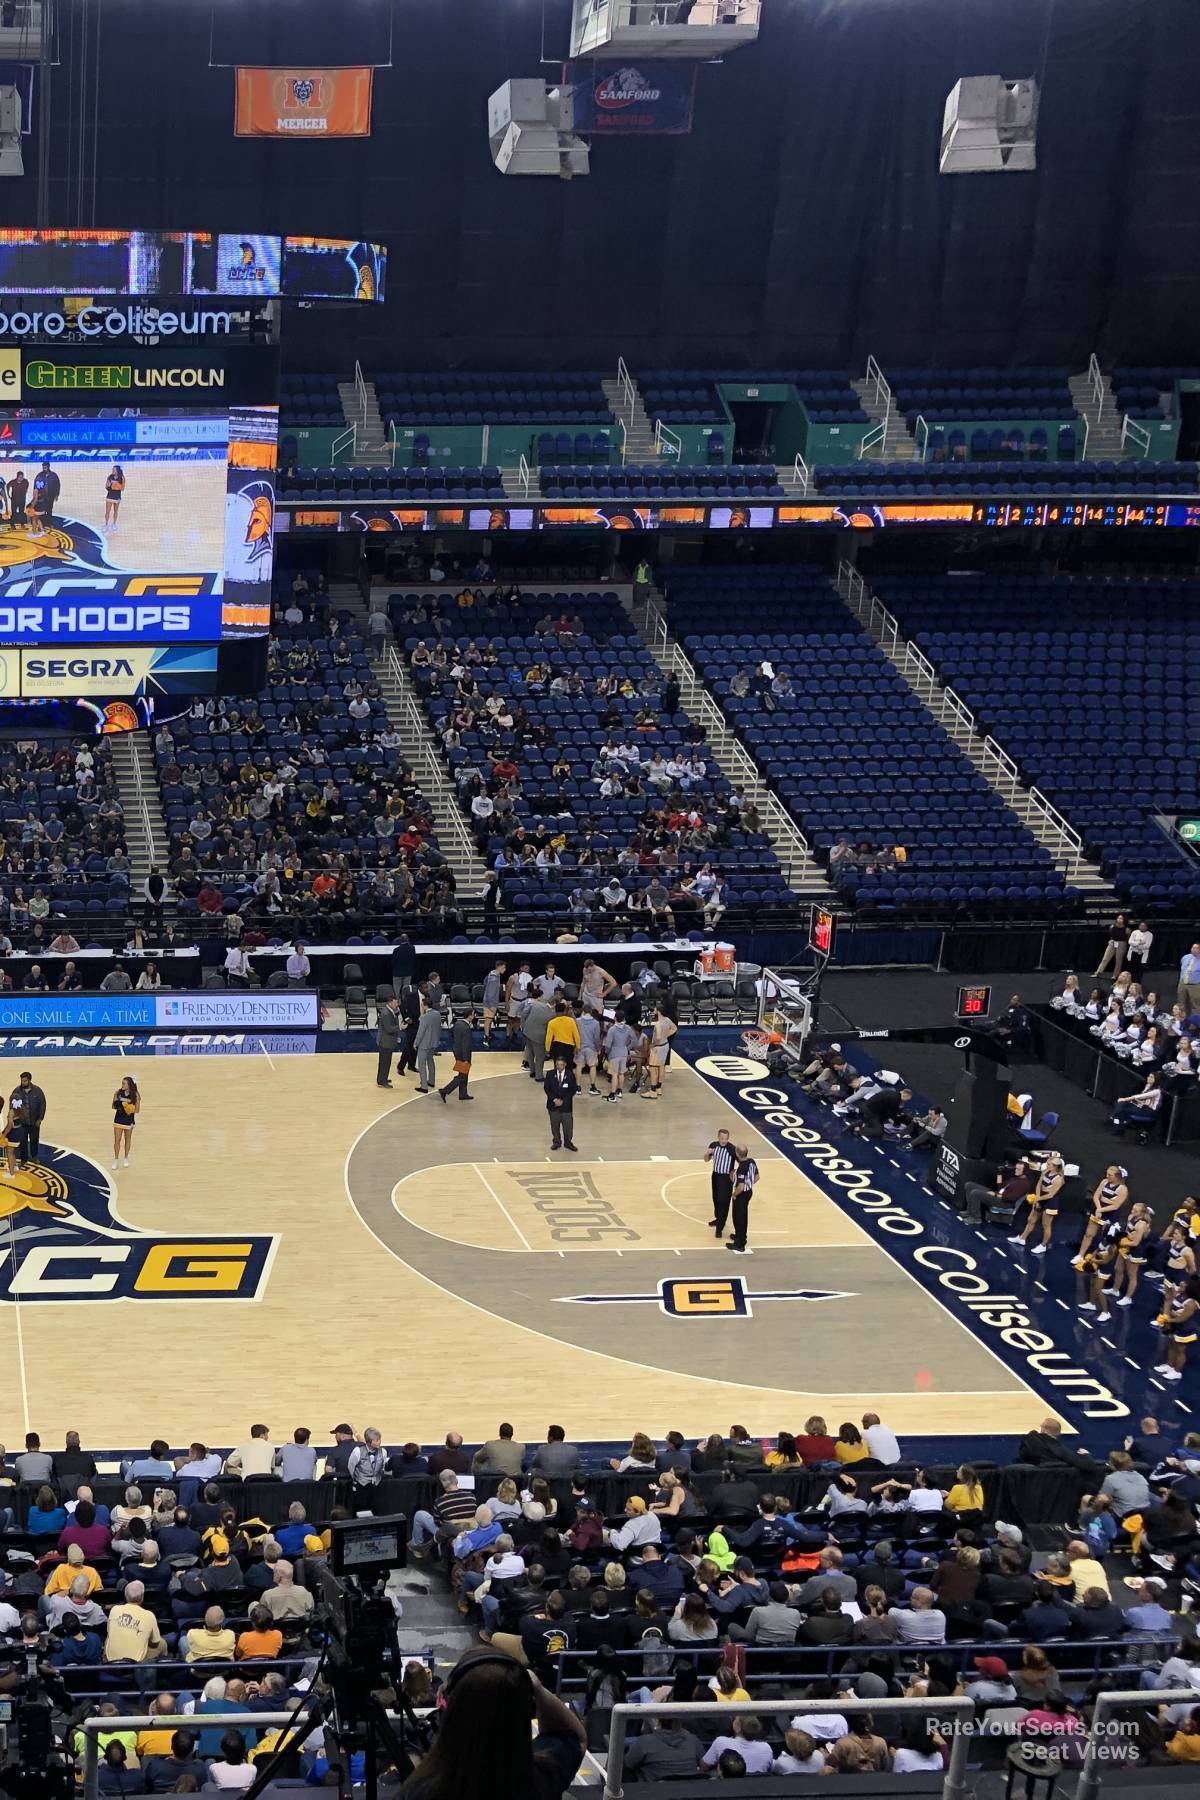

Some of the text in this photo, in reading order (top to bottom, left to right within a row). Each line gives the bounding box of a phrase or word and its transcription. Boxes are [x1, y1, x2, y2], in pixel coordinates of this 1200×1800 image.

[599, 90, 661, 100] SAMFORD
[277, 118, 328, 129] MERCER
[78, 305, 230, 335] Coliseum
[27, 361, 225, 388] GREEN LINCOLN
[976, 509, 984, 521] 1
[1011, 509, 1021, 521] 2
[1049, 508, 1059, 521] 4
[1087, 508, 1103, 520] 14
[1127, 509, 1145, 521] 44
[52, 606, 191, 632] HOOPS
[26, 659, 134, 678] SEGRA
[182, 1001, 311, 1016] FRIENDLY DENTISTRY
[964, 1001, 981, 1012] 30
[2, 1010, 149, 1024] ONE SMILE AT A TIME
[859, 1030, 889, 1038] SPALDING
[739, 1087, 1131, 1418] Greensboro Coliseum
[672, 1282, 736, 1312] G
